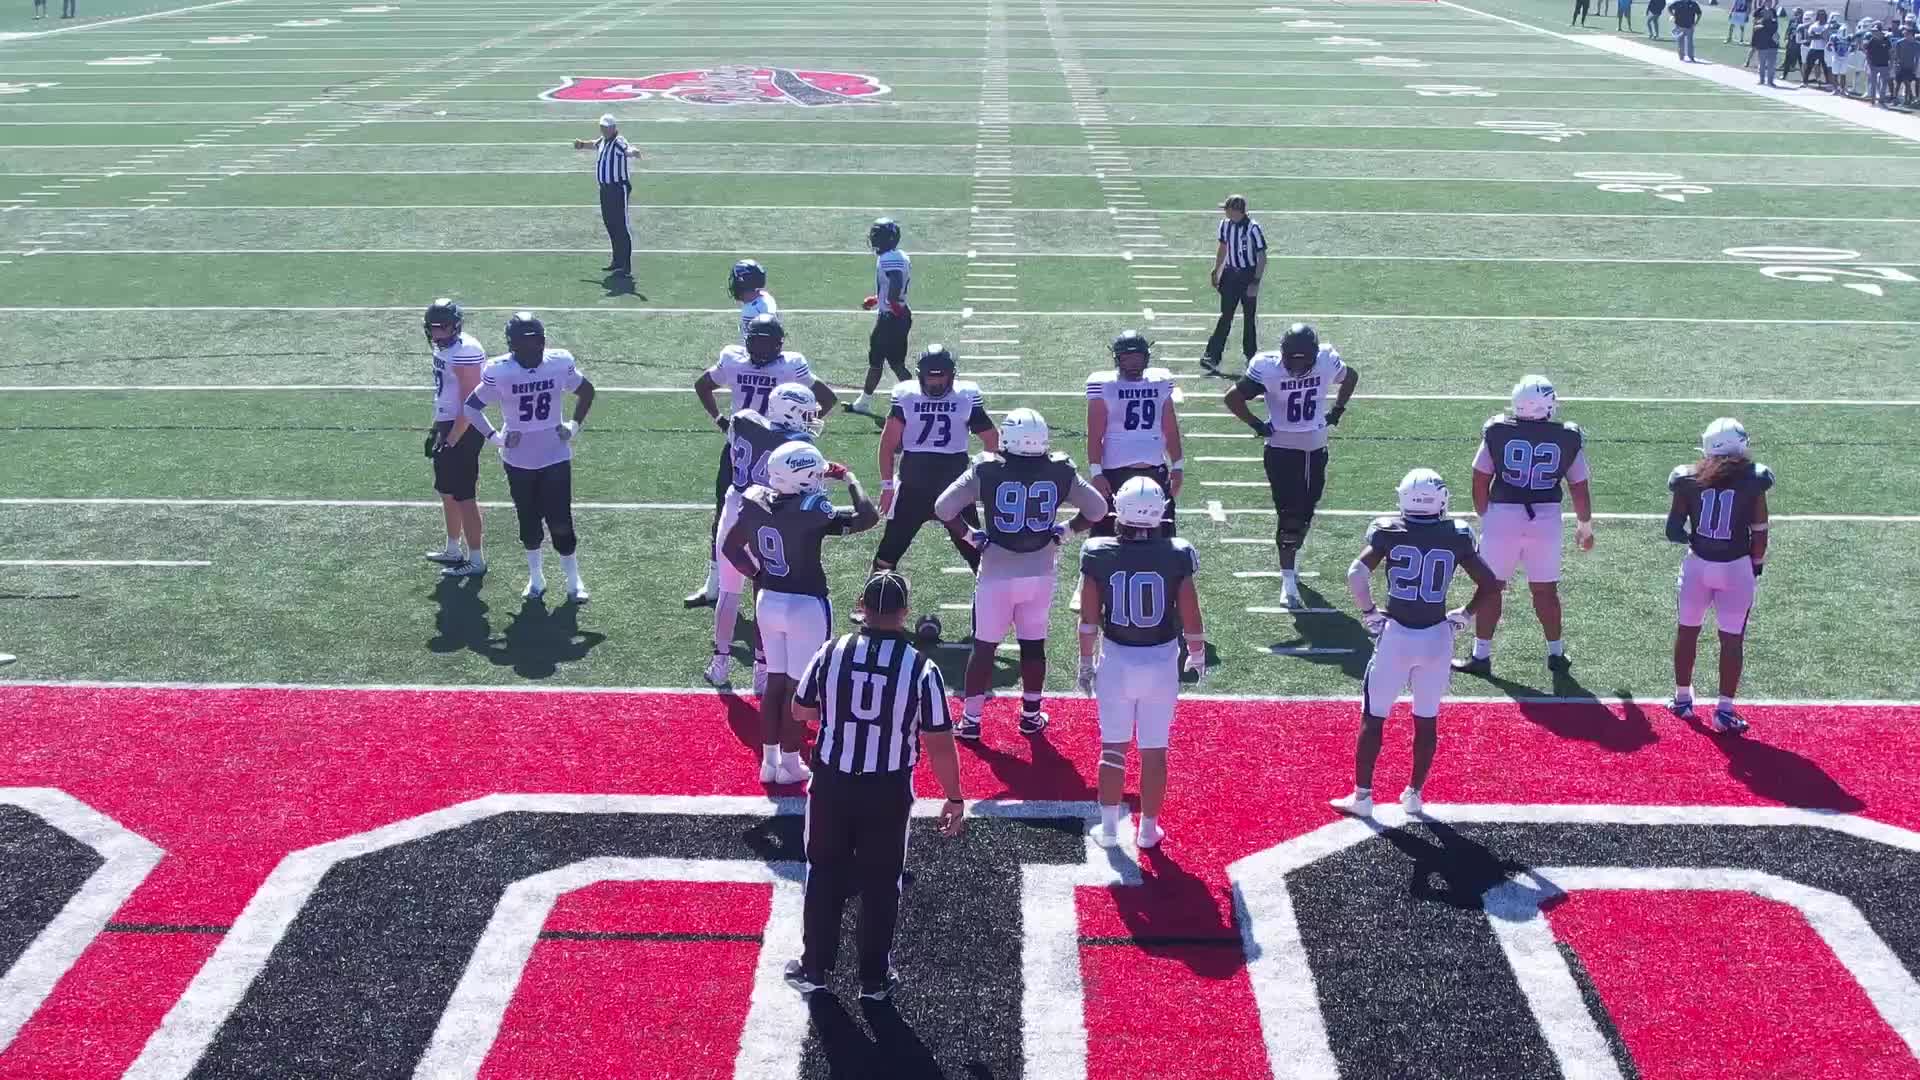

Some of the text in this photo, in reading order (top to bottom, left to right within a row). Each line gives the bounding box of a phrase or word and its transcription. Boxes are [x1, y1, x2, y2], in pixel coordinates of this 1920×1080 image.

[1573, 171, 1713, 195] 30
[1722, 245, 1920, 283] 20
[511, 378, 556, 395] REIVERS
[740, 386, 773, 416] 77
[1118, 387, 1159, 400] REIVERS
[518, 395, 551, 422] 58
[1124, 399, 1156, 430] 69
[1286, 388, 1317, 422] 66
[915, 413, 952, 447] 73
[1501, 439, 1561, 490] 92
[993, 480, 1058, 534] 93
[1696, 487, 1735, 540] 11
[756, 525, 790, 577] 9
[1387, 544, 1456, 603] 20
[1109, 570, 1165, 628] 10
[850, 670, 888, 721] U
